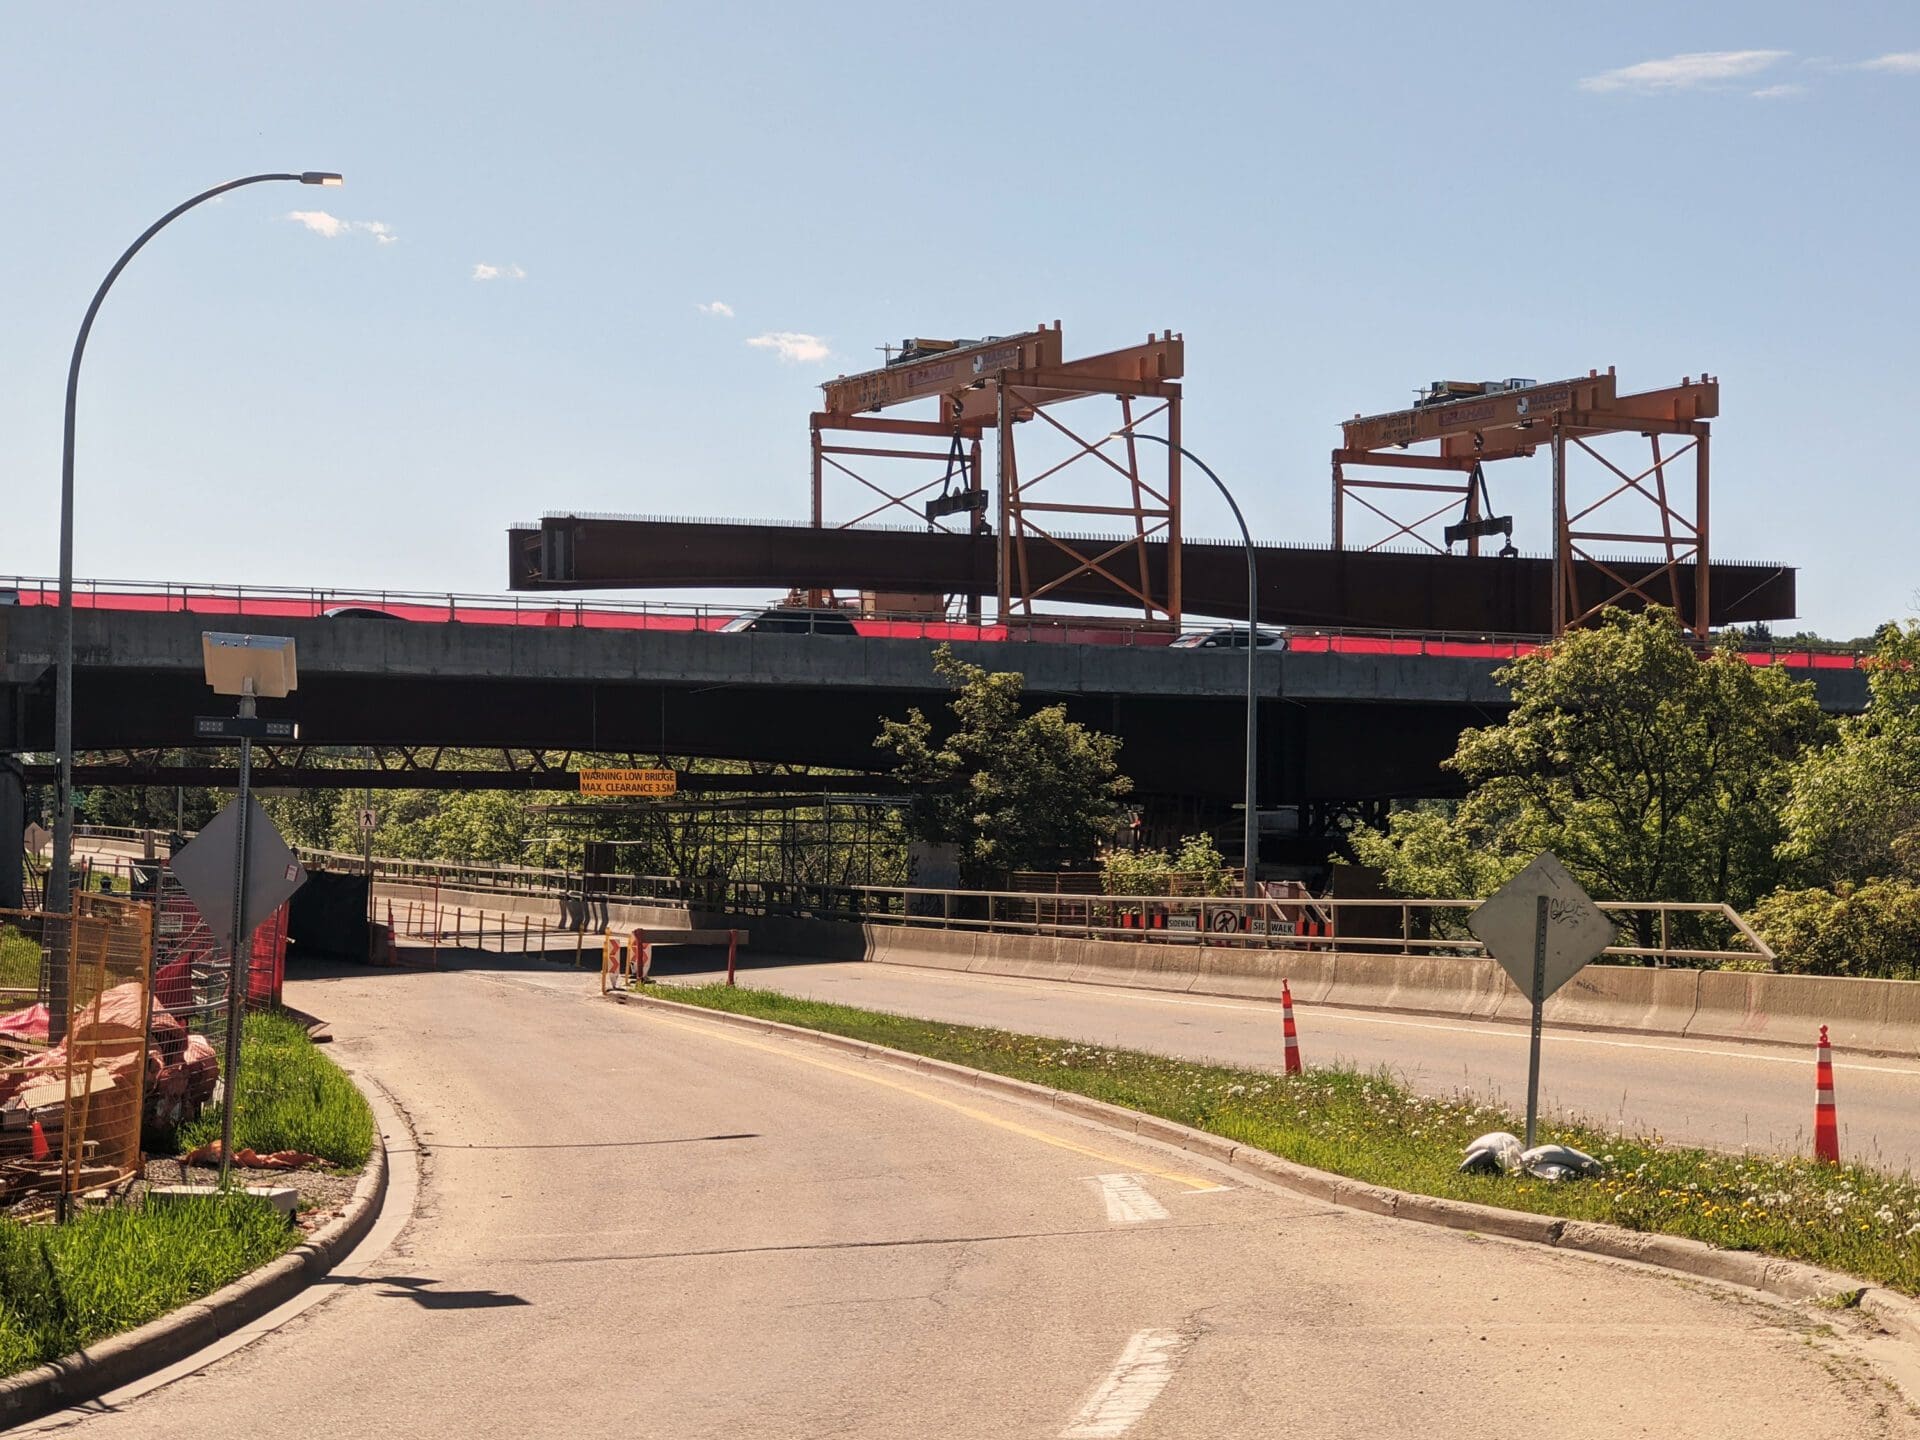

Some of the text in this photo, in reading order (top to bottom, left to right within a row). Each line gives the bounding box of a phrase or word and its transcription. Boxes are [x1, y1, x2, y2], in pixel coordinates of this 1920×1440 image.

[582, 771, 674, 782] WARNING LOW BRIDGE
[582, 783, 674, 793] MAX. CLEARANCE 3.5M
[1168, 919, 1195, 928] SIDEWALK
[1253, 922, 1293, 933] SIDWALK
